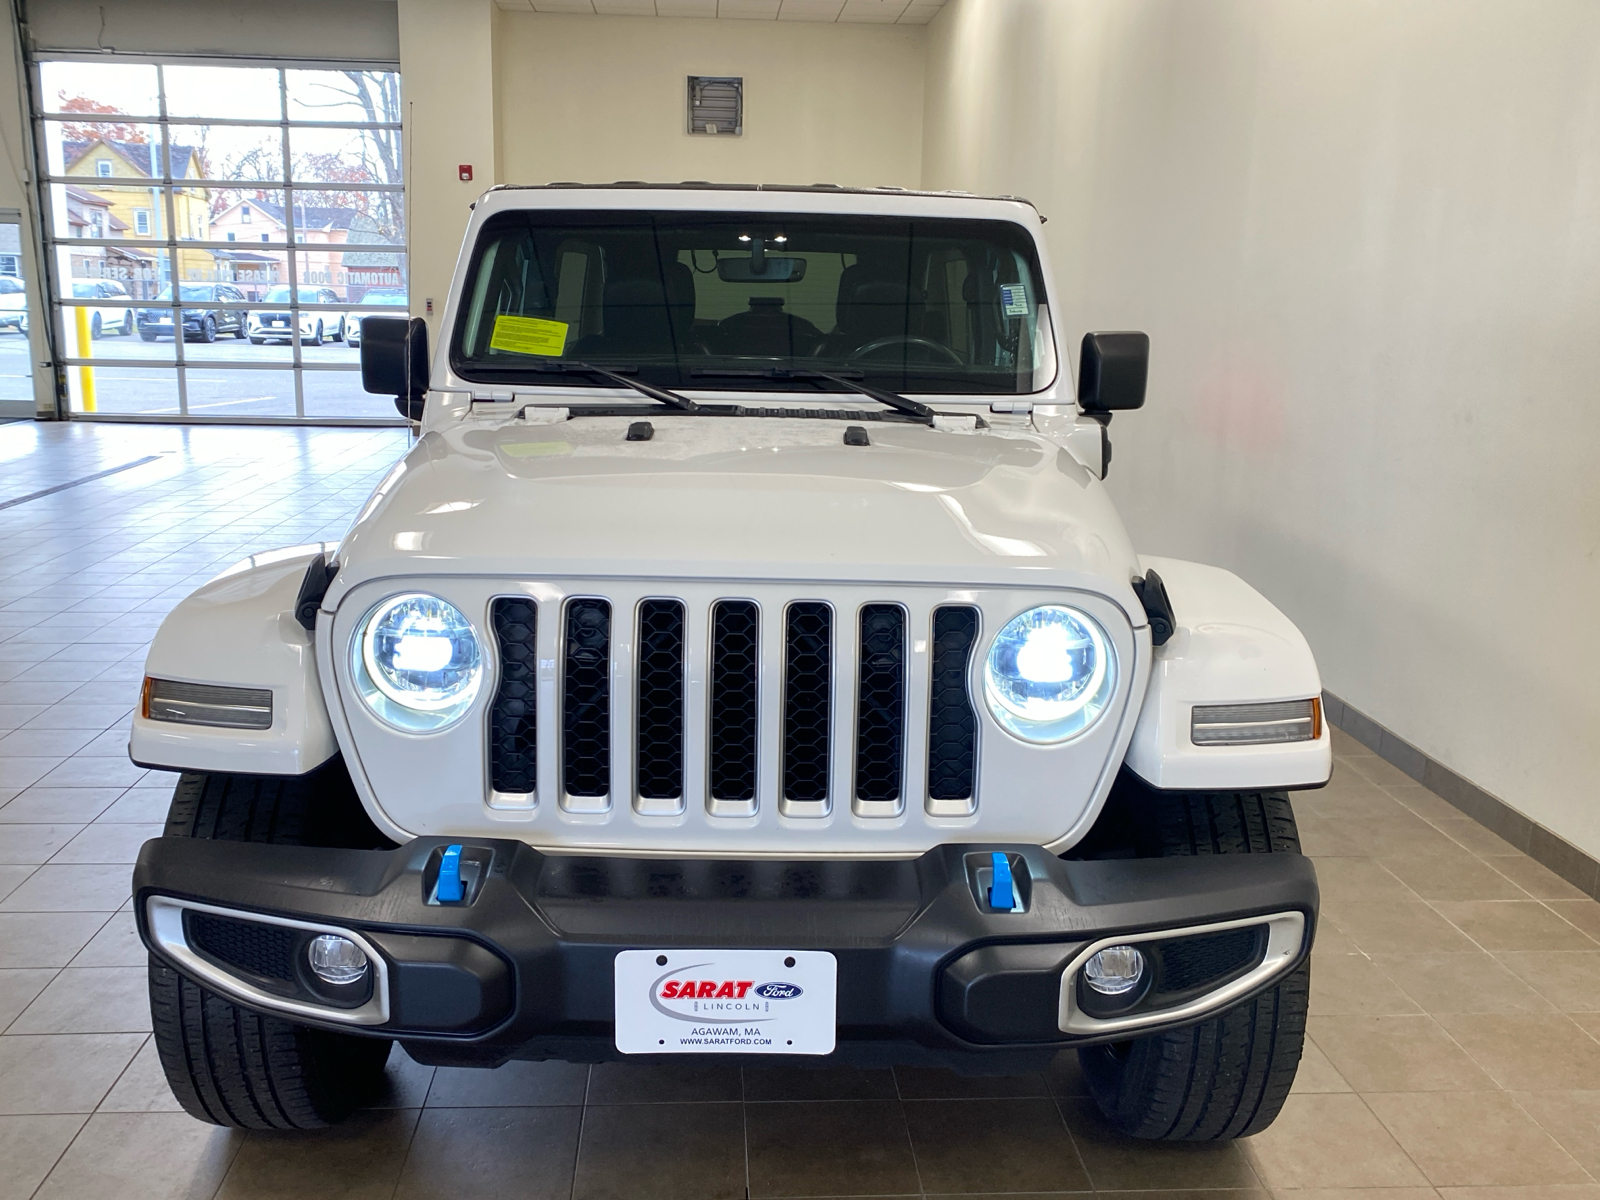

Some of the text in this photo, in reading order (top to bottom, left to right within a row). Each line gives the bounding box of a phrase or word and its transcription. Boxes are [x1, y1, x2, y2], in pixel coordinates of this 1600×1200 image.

[660, 980, 795, 999] SARAT Ford
[703, 1003, 760, 1011] LINCOLN
[691, 1027, 761, 1037] AGAWAM, MA
[680, 1038, 772, 1046] WWW.SARATFORD.COM
